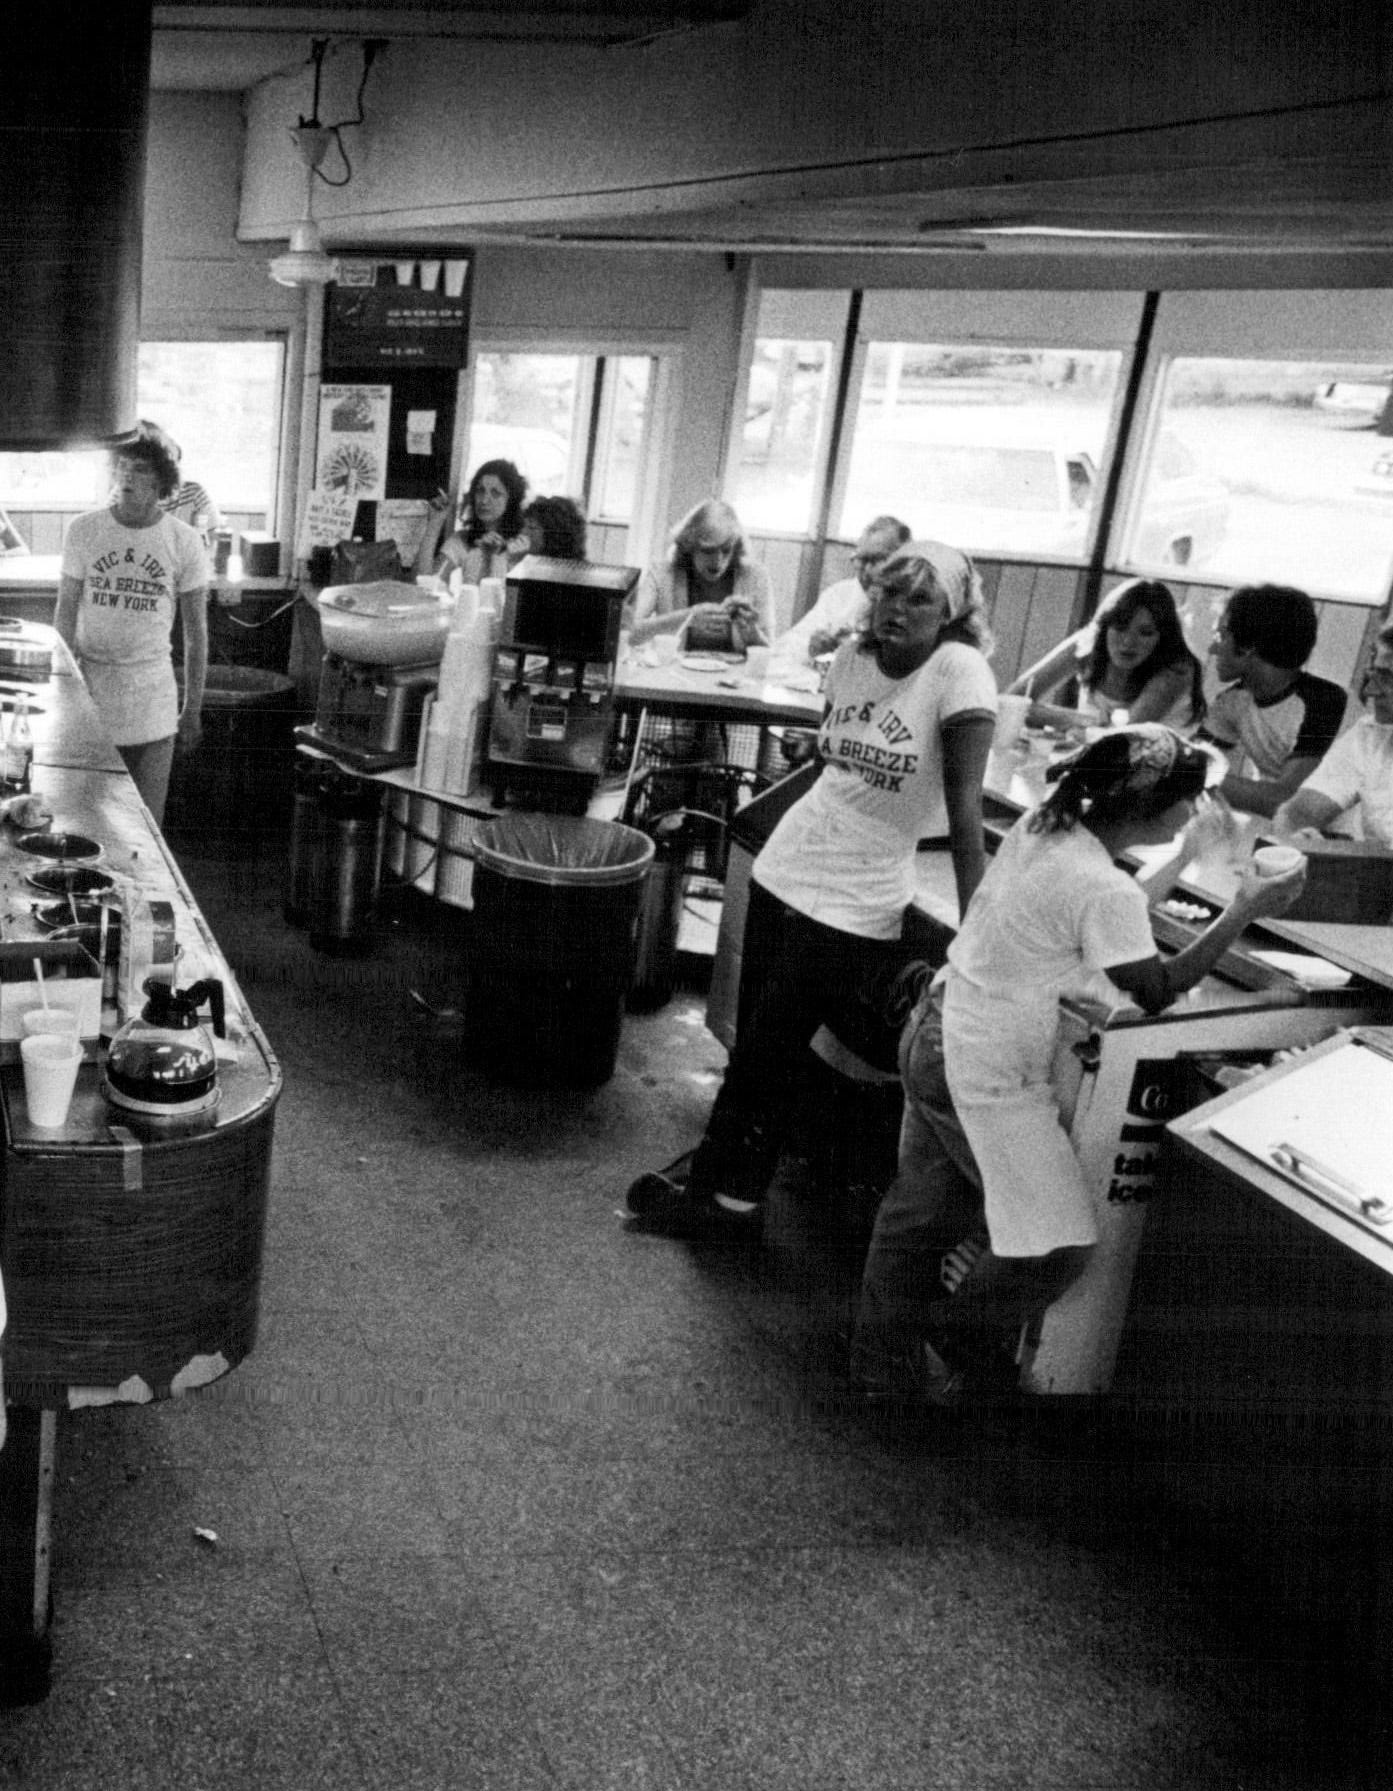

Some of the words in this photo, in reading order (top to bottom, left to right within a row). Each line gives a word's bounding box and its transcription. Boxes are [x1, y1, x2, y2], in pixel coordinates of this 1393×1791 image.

[92, 551, 119, 574] VIC
[124, 548, 135, 563] &
[140, 554, 166, 579] IRV
[92, 592, 120, 609] NEW
[124, 595, 157, 612] YORK
[859, 702, 876, 723] &
[878, 710, 913, 745] IRV
[839, 738, 918, 774] BREEZE
